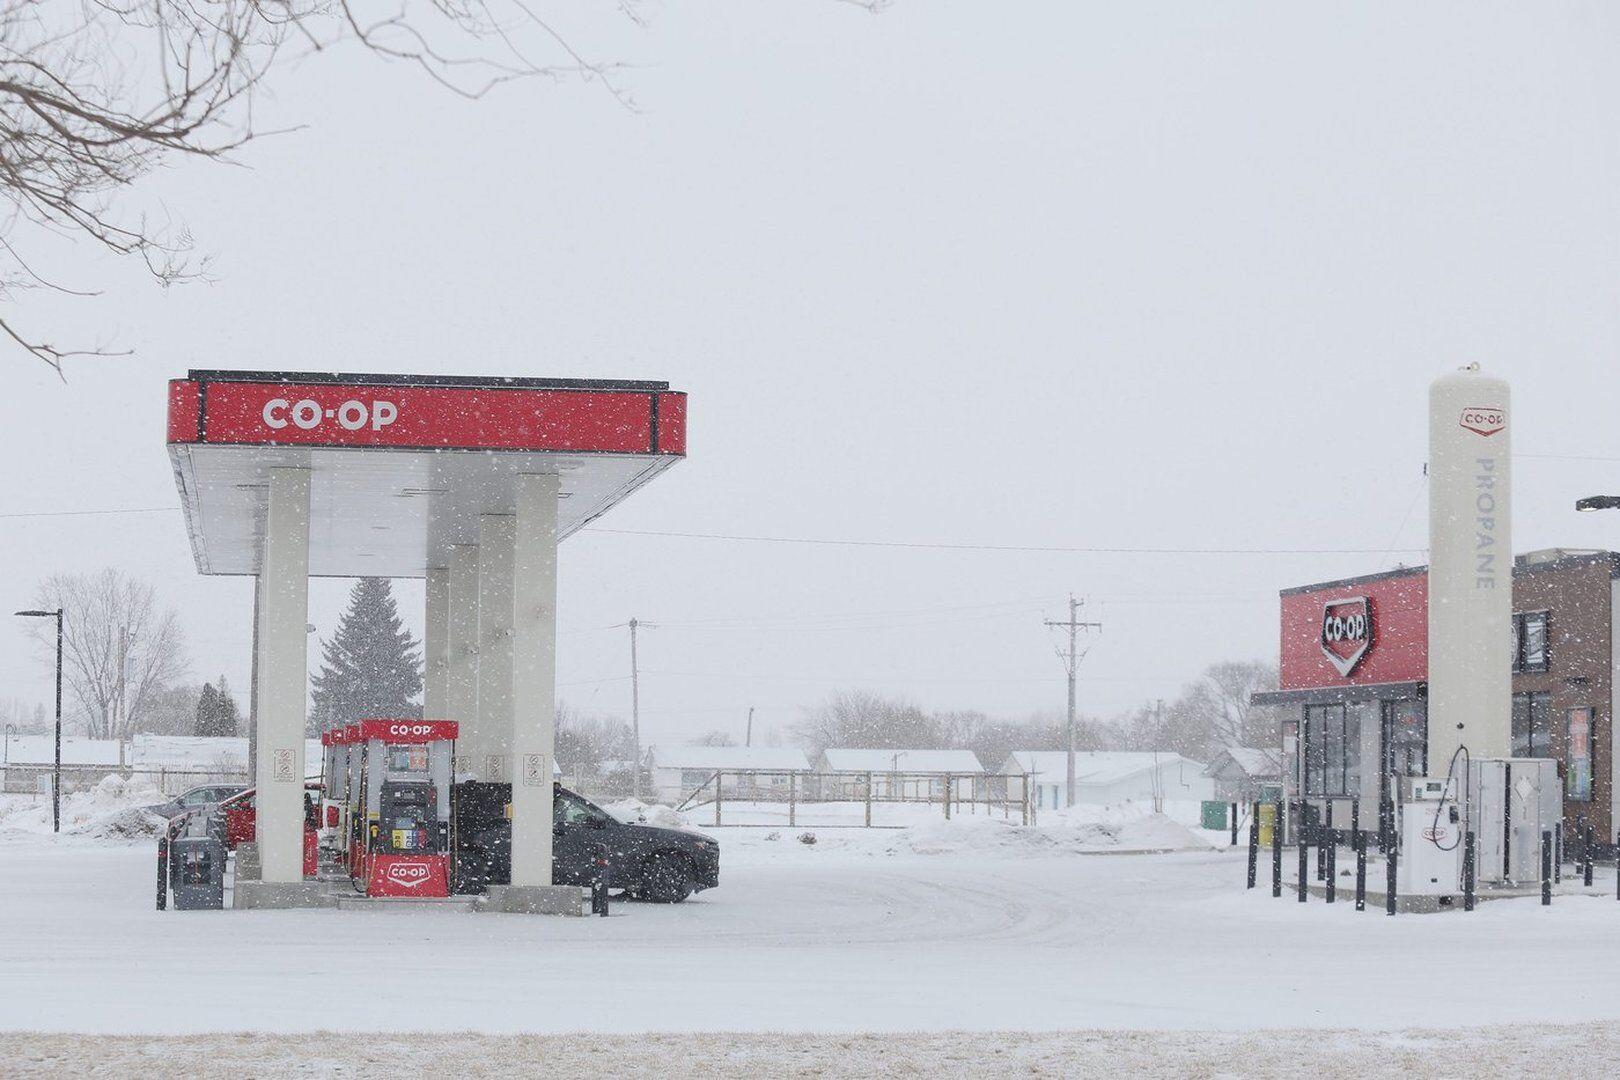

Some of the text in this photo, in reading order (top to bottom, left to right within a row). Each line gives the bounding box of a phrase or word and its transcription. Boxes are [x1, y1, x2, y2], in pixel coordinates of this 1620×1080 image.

[262, 398, 398, 431] CO-OP
[1476, 458, 1496, 589] PROPANE
[1325, 614, 1364, 641] CO-OP
[390, 724, 431, 735] CO-OP
[391, 868, 426, 877] CO-OP
